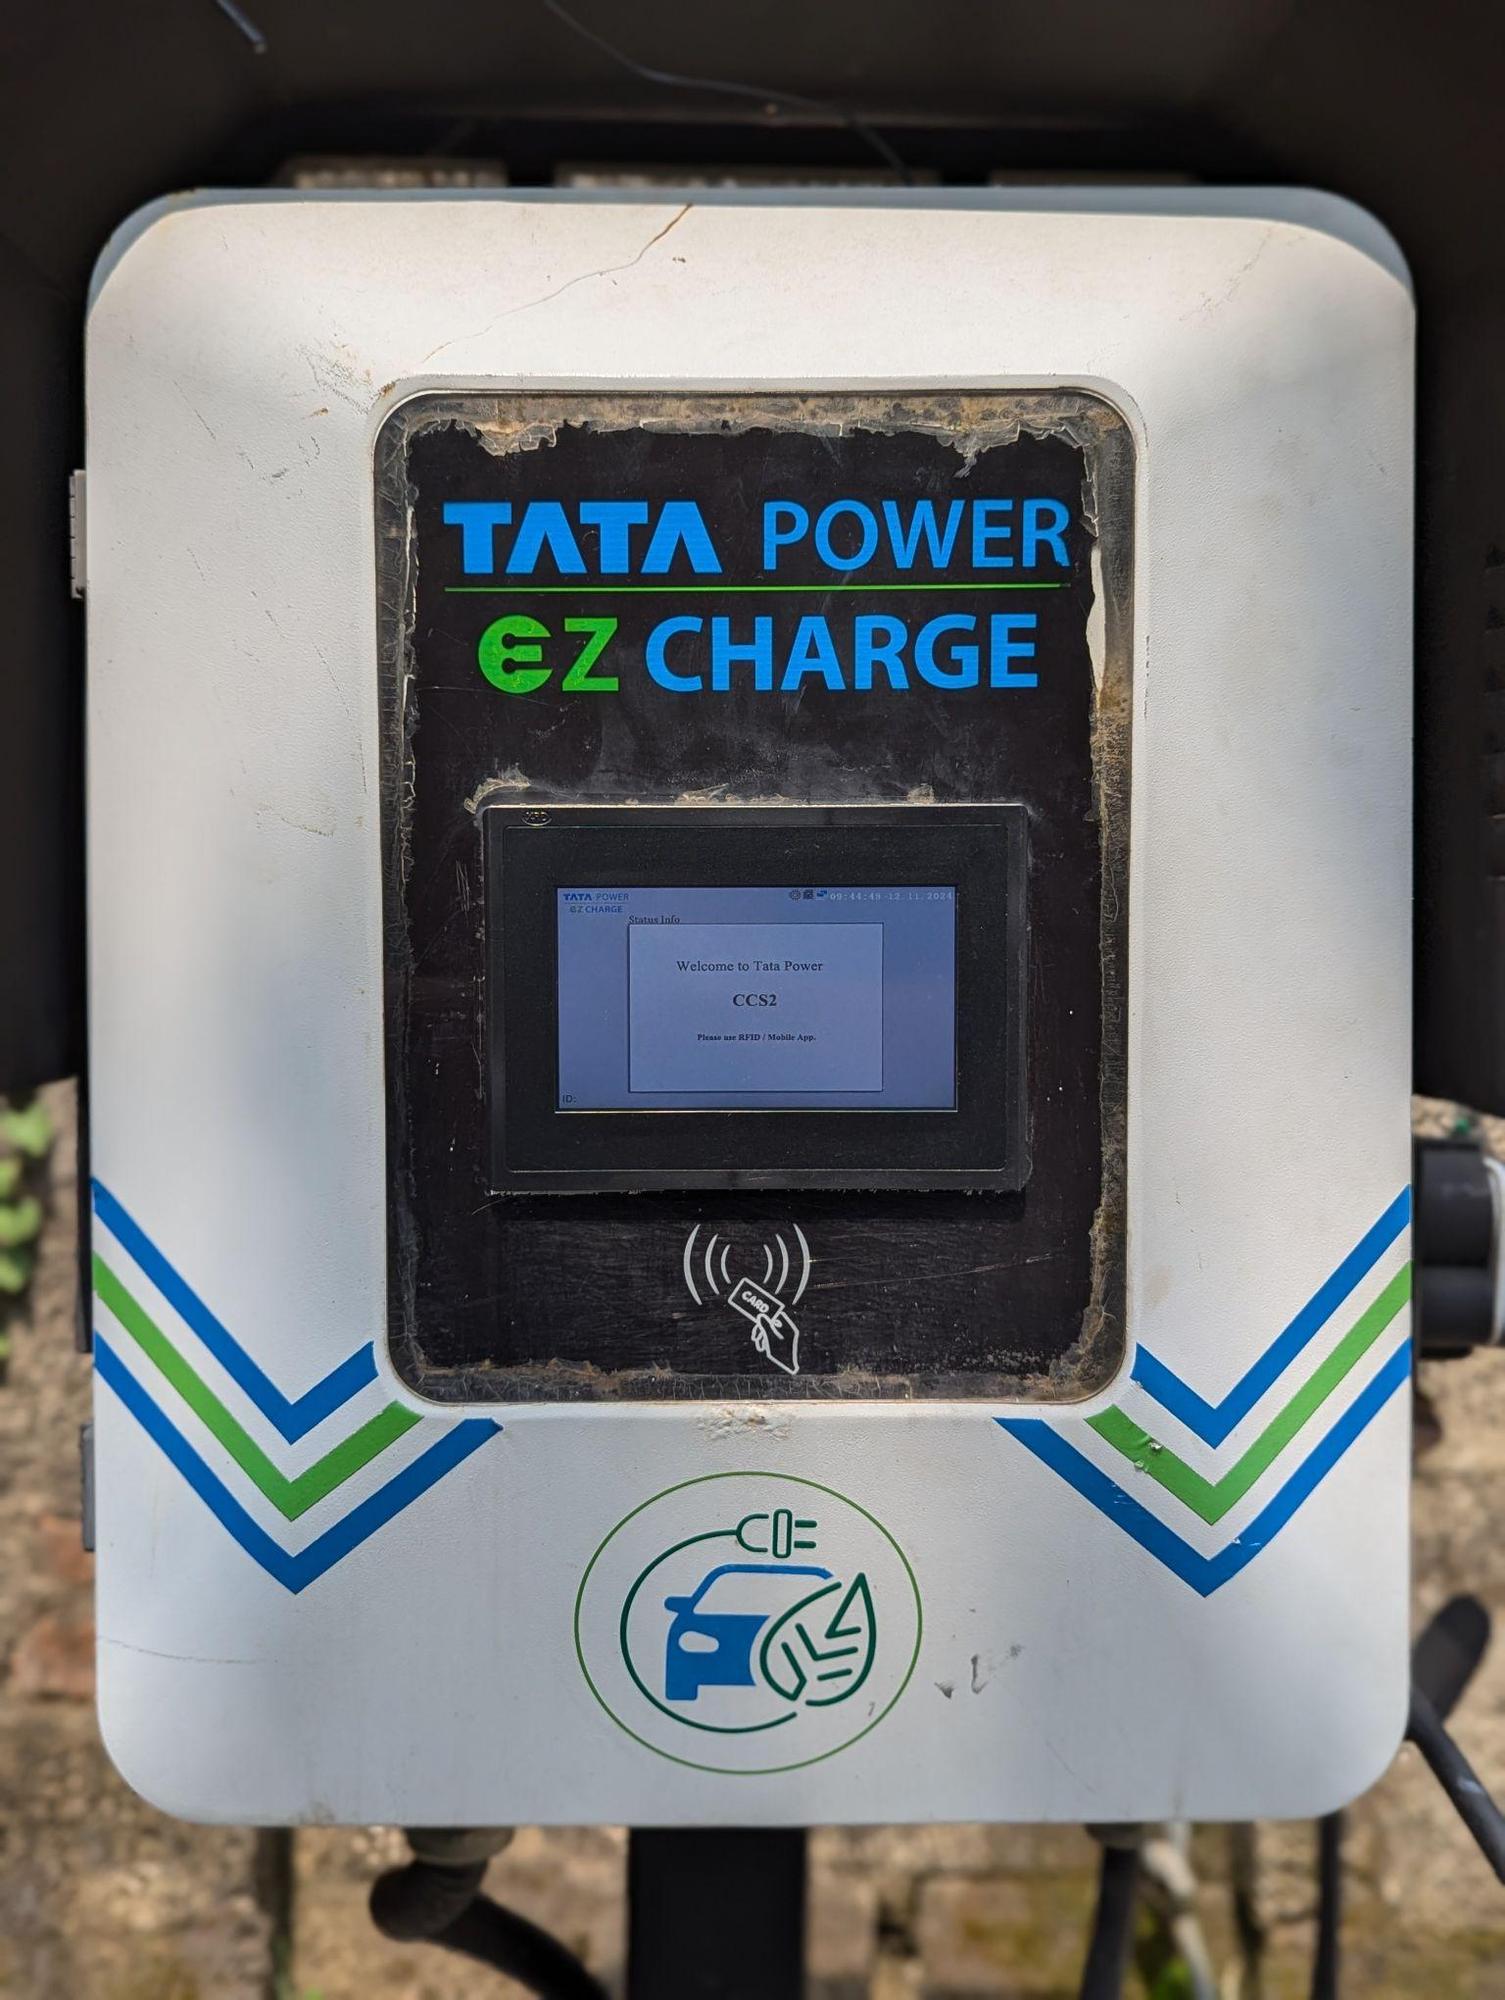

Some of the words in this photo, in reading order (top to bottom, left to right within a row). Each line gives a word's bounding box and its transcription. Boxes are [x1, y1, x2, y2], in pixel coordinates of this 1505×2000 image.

[443, 501, 722, 574] TATA
[763, 499, 1071, 571] POWER
[645, 613, 1039, 692] CHARGE
[563, 893, 592, 901] TATA
[596, 893, 630, 901] POWER
[585, 905, 624, 913] CHARGE
[628, 915, 658, 925] Status
[661, 914, 681, 925] Info
[676, 960, 735, 972] Welcome
[738, 961, 750, 972] to
[753, 960, 781, 972] Tata
[784, 960, 824, 972] Power
[732, 993, 778, 1007] CCS2
[697, 1033, 722, 1041] Please
[738, 1033, 761, 1041] RFID
[767, 1033, 796, 1041] Mobile
[562, 1094, 577, 1103] ID:
[741, 1290, 770, 1314] CARD
